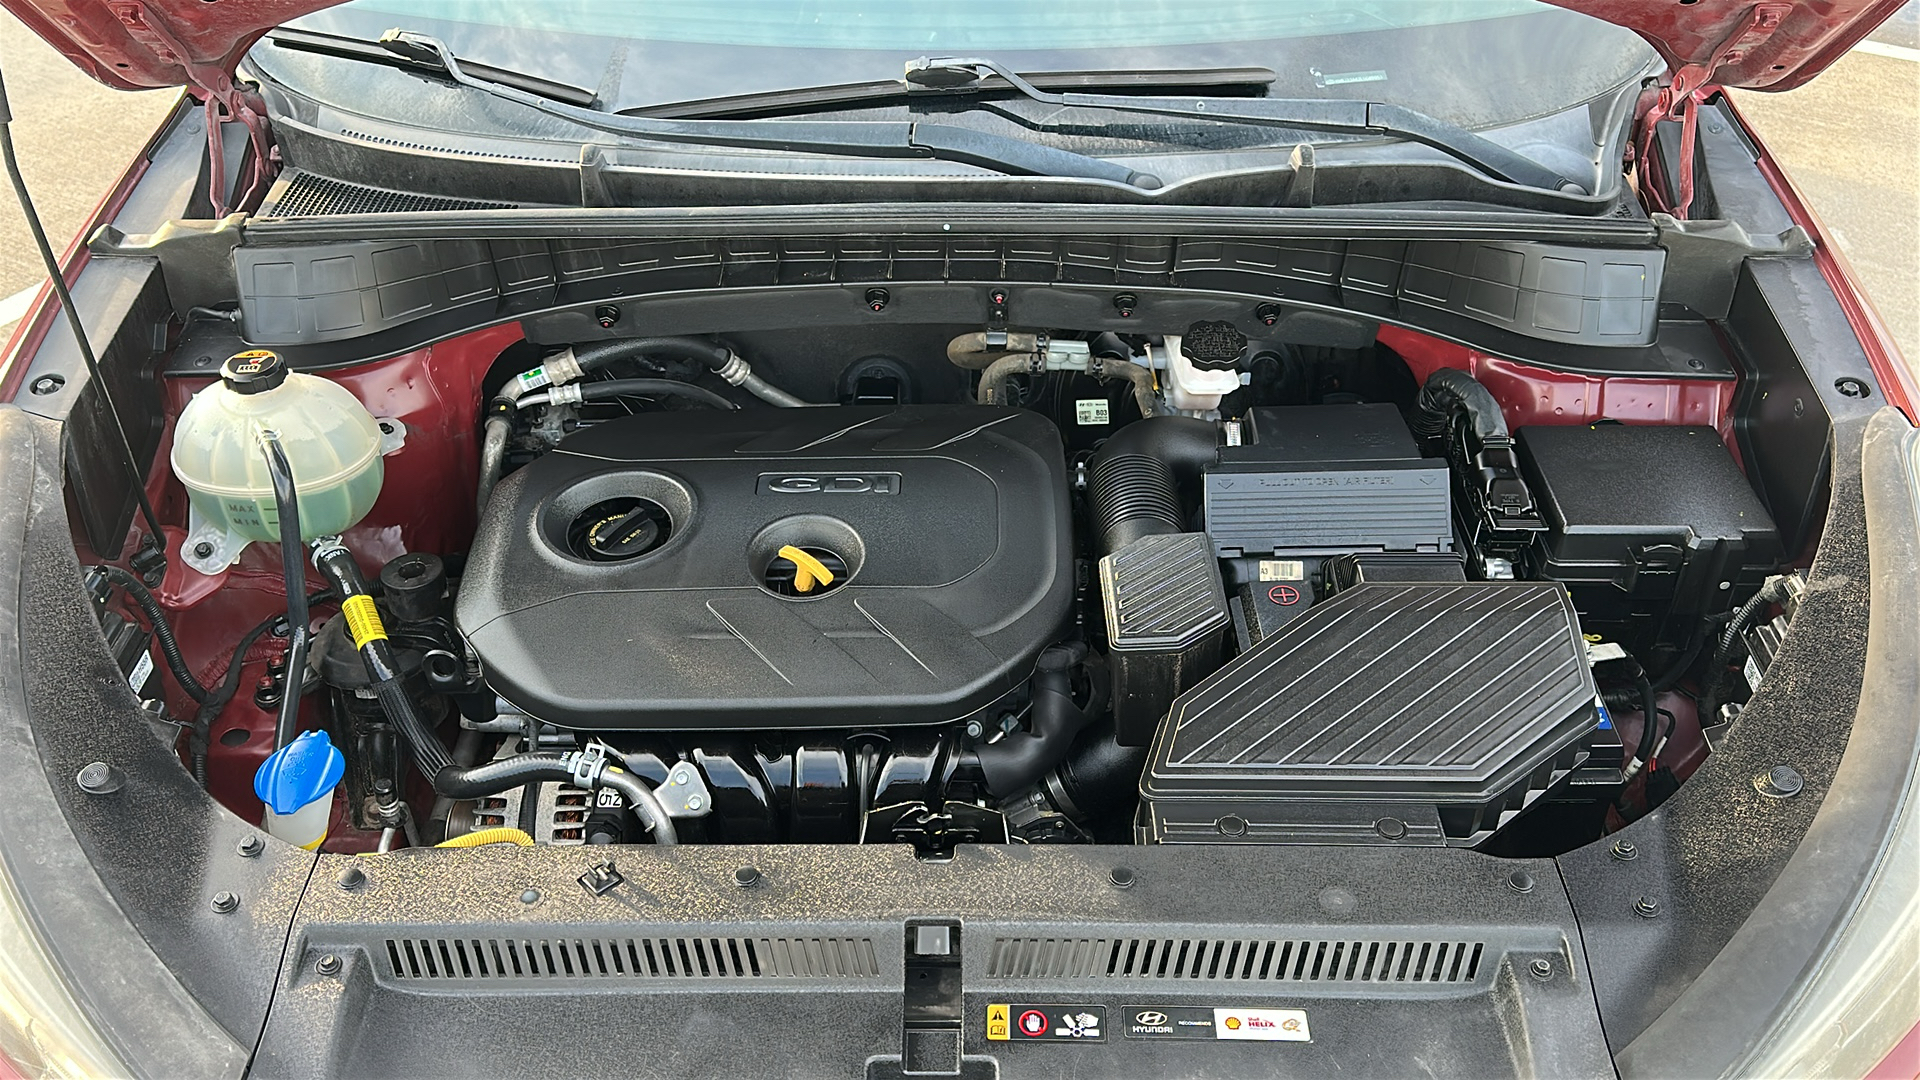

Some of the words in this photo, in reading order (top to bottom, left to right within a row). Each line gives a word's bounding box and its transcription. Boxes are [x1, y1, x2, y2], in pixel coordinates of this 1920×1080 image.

[767, 477, 889, 493] GDI
[228, 504, 255, 513] MAX
[233, 518, 260, 526] MIN
[1248, 1020, 1277, 1028] HELIX
[1132, 1025, 1173, 1034] HYUNDAI
